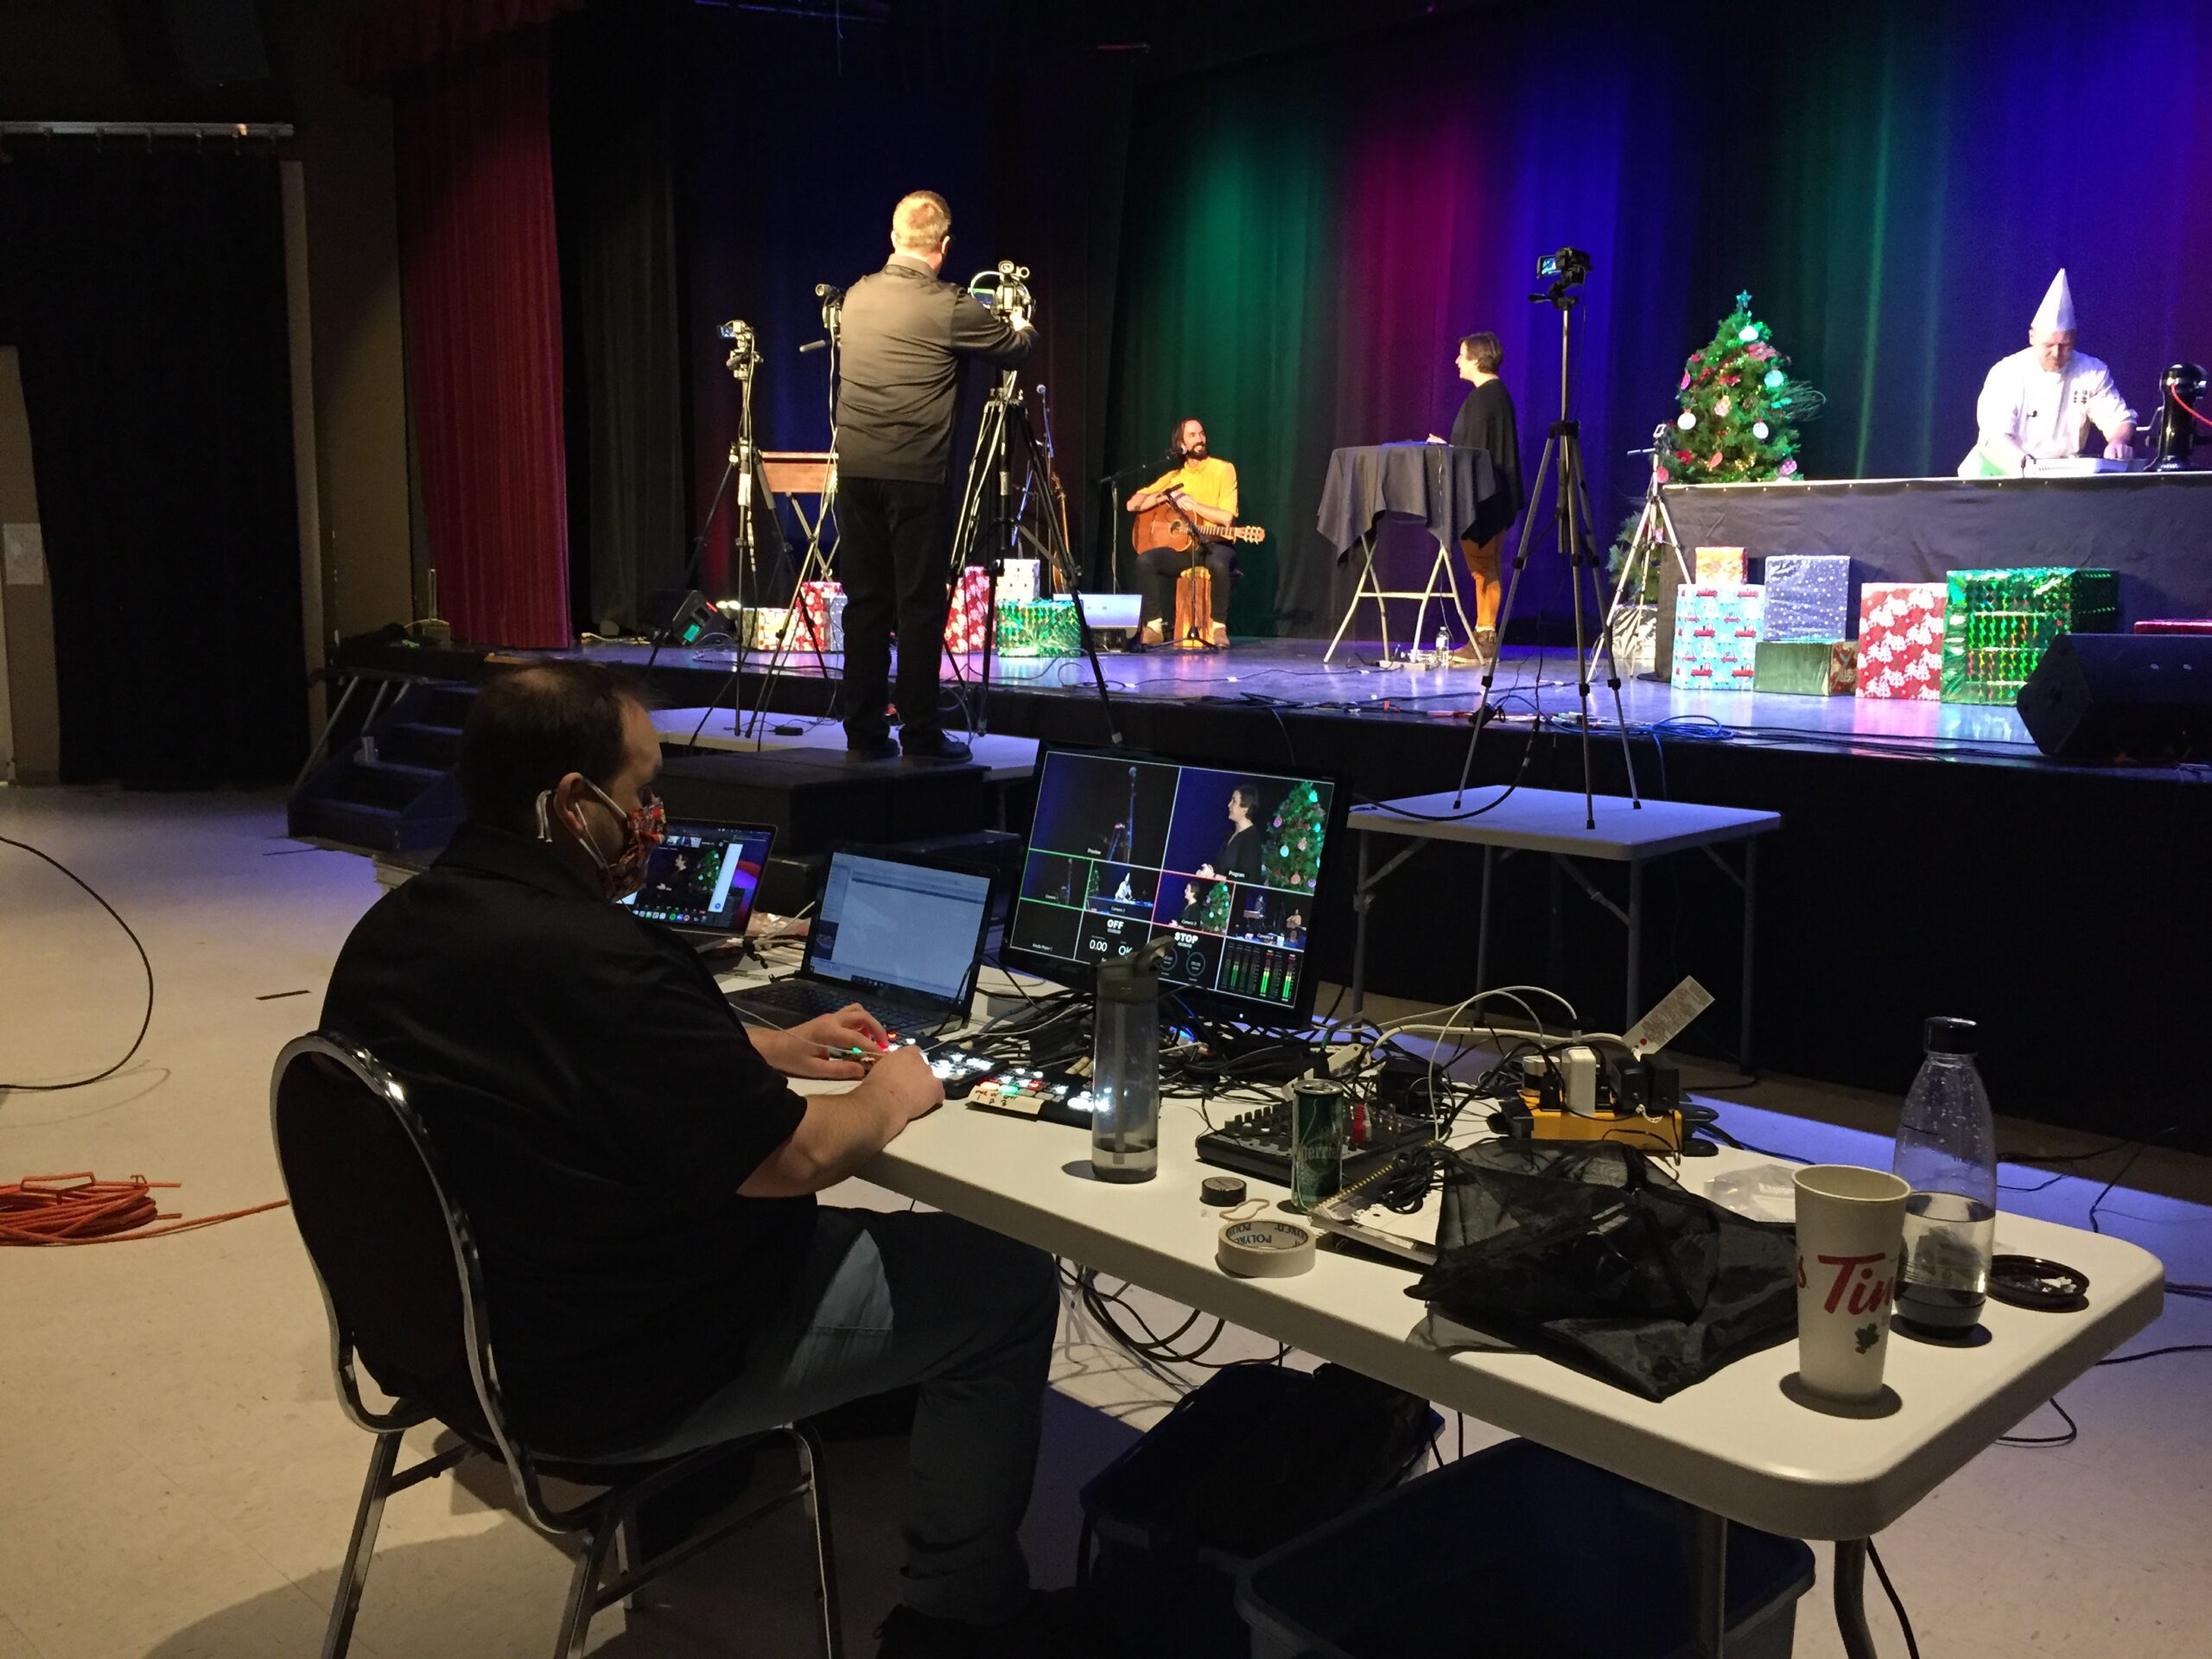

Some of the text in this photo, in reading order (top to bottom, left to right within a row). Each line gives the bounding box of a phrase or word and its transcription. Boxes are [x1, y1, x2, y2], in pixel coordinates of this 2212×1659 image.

[1107, 919, 1124, 930] OFF
[1174, 931, 1198, 944] STOP
[1089, 939, 1108, 952] 0.00
